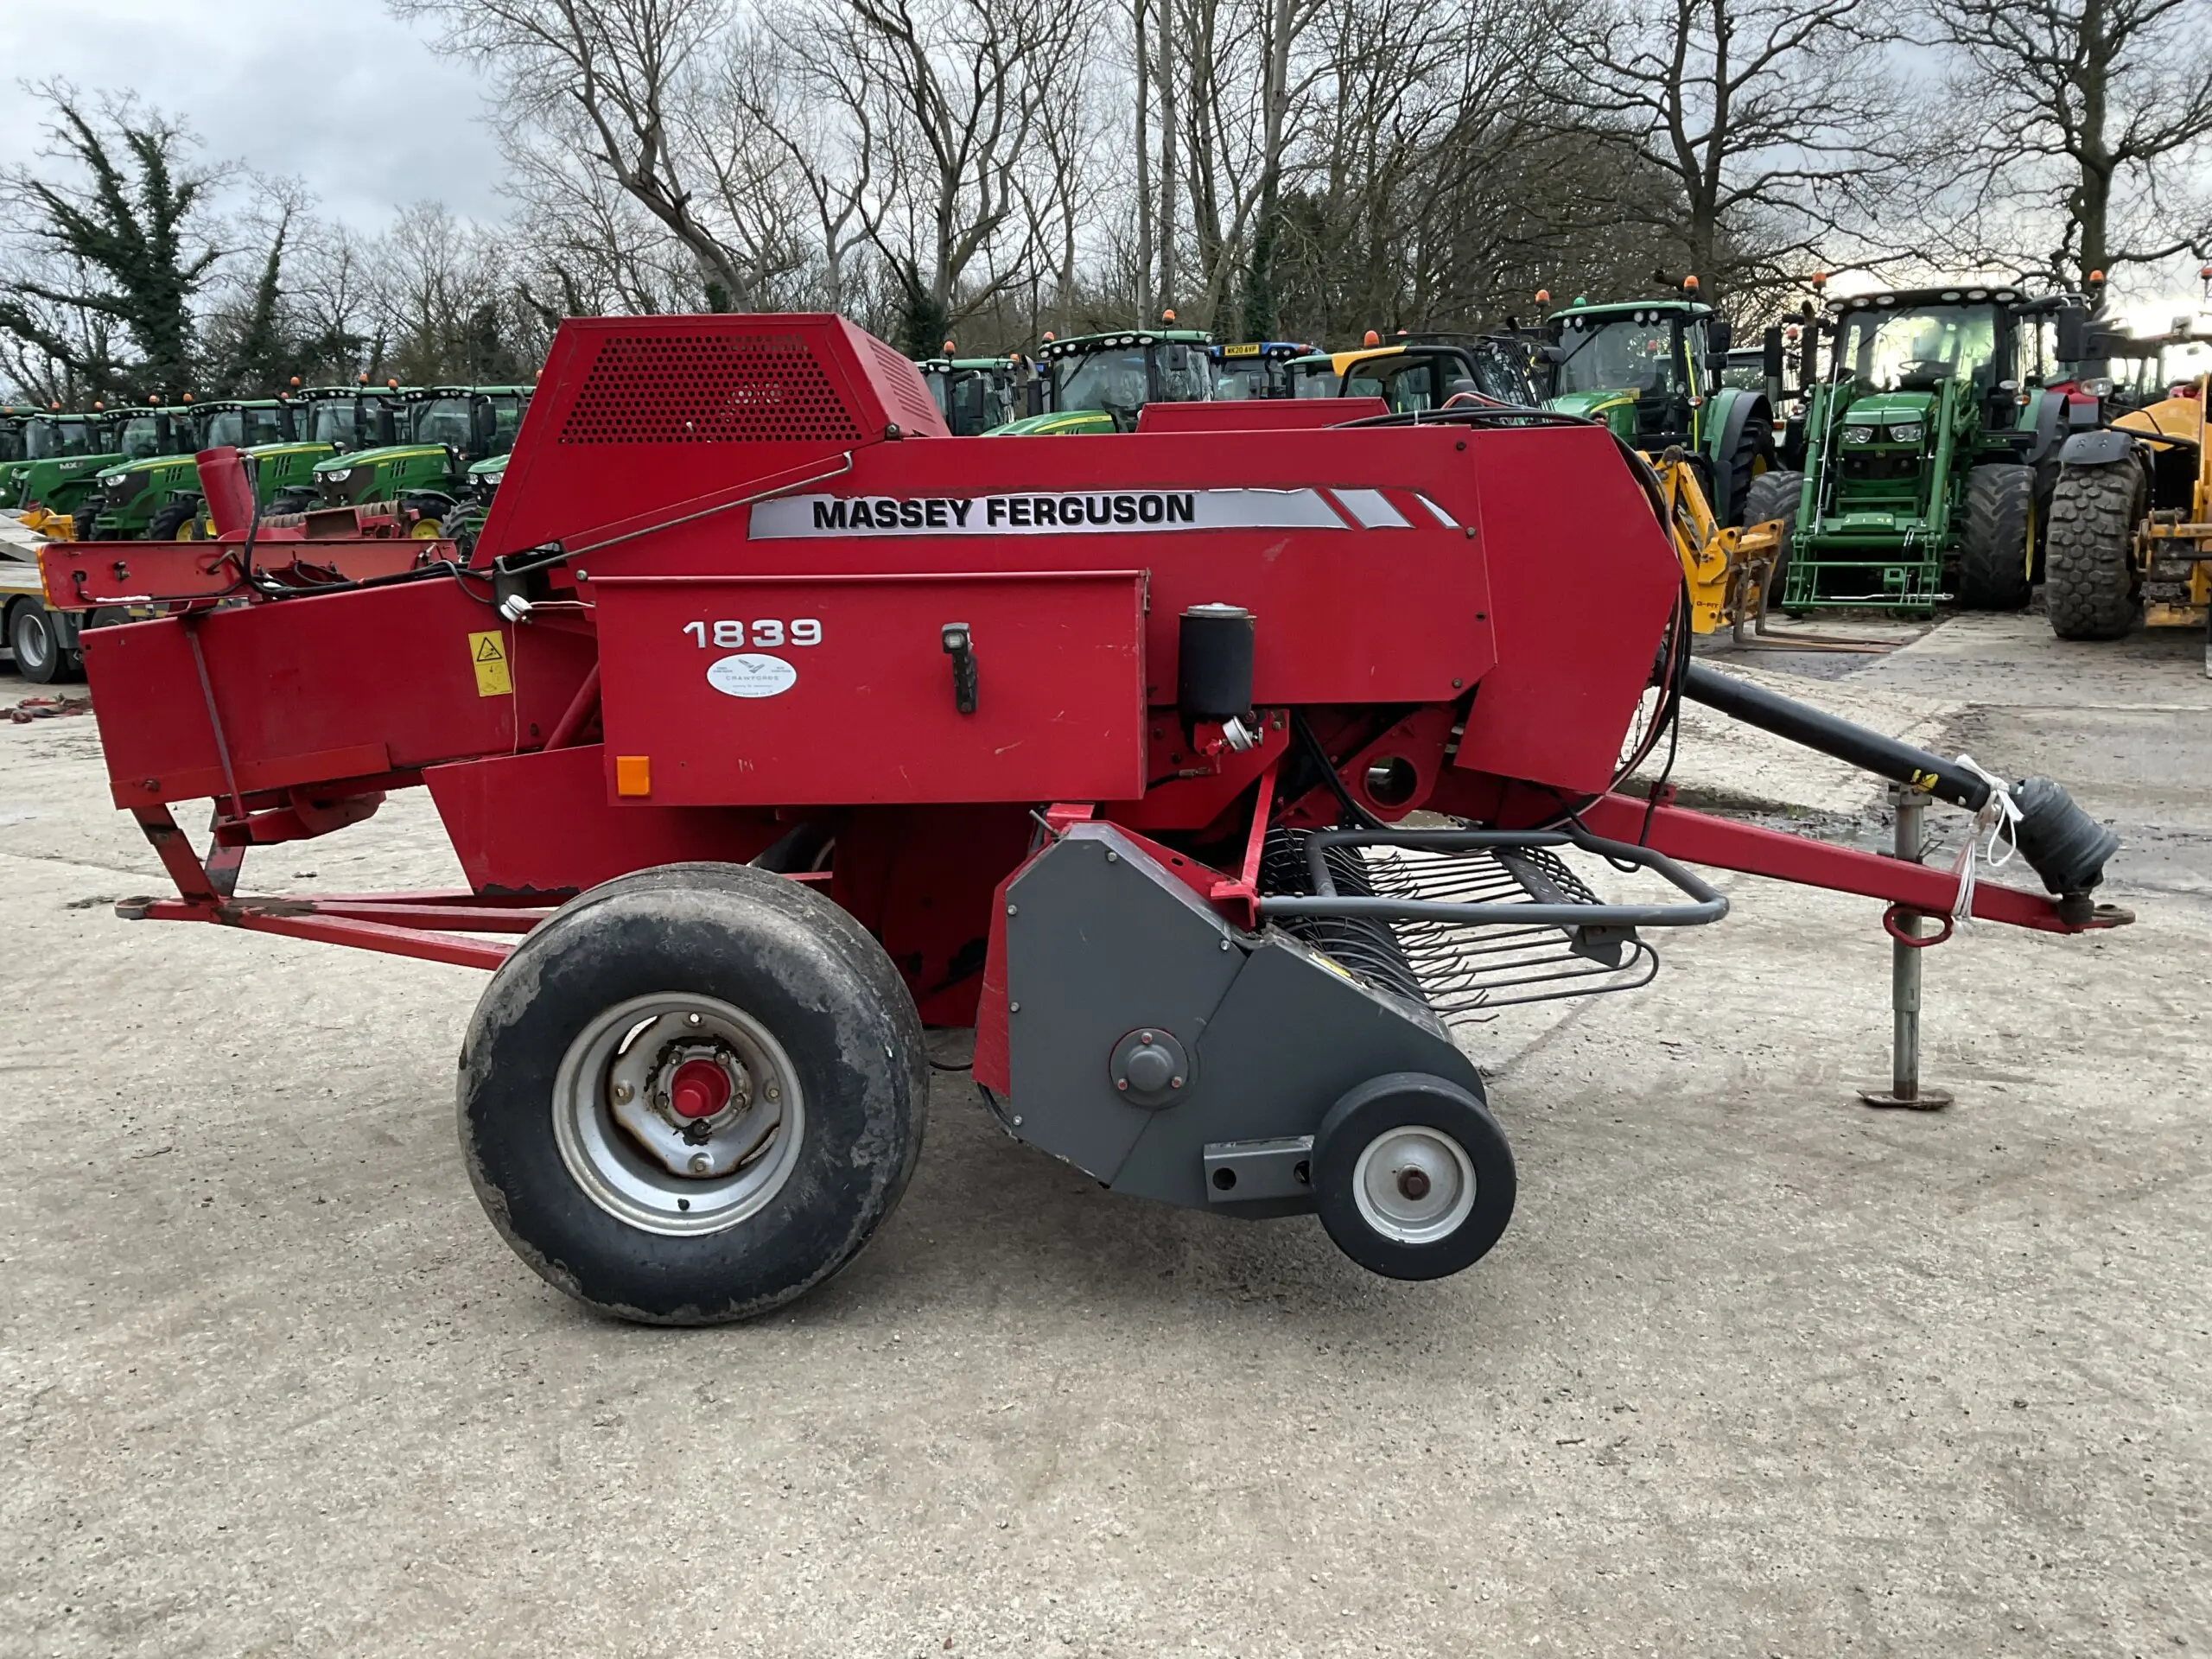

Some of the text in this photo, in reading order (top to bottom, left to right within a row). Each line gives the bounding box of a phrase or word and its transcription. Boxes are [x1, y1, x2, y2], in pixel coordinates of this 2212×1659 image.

[813, 493, 1195, 529] MASSEY FERGUSON
[683, 619, 823, 648] 1839
